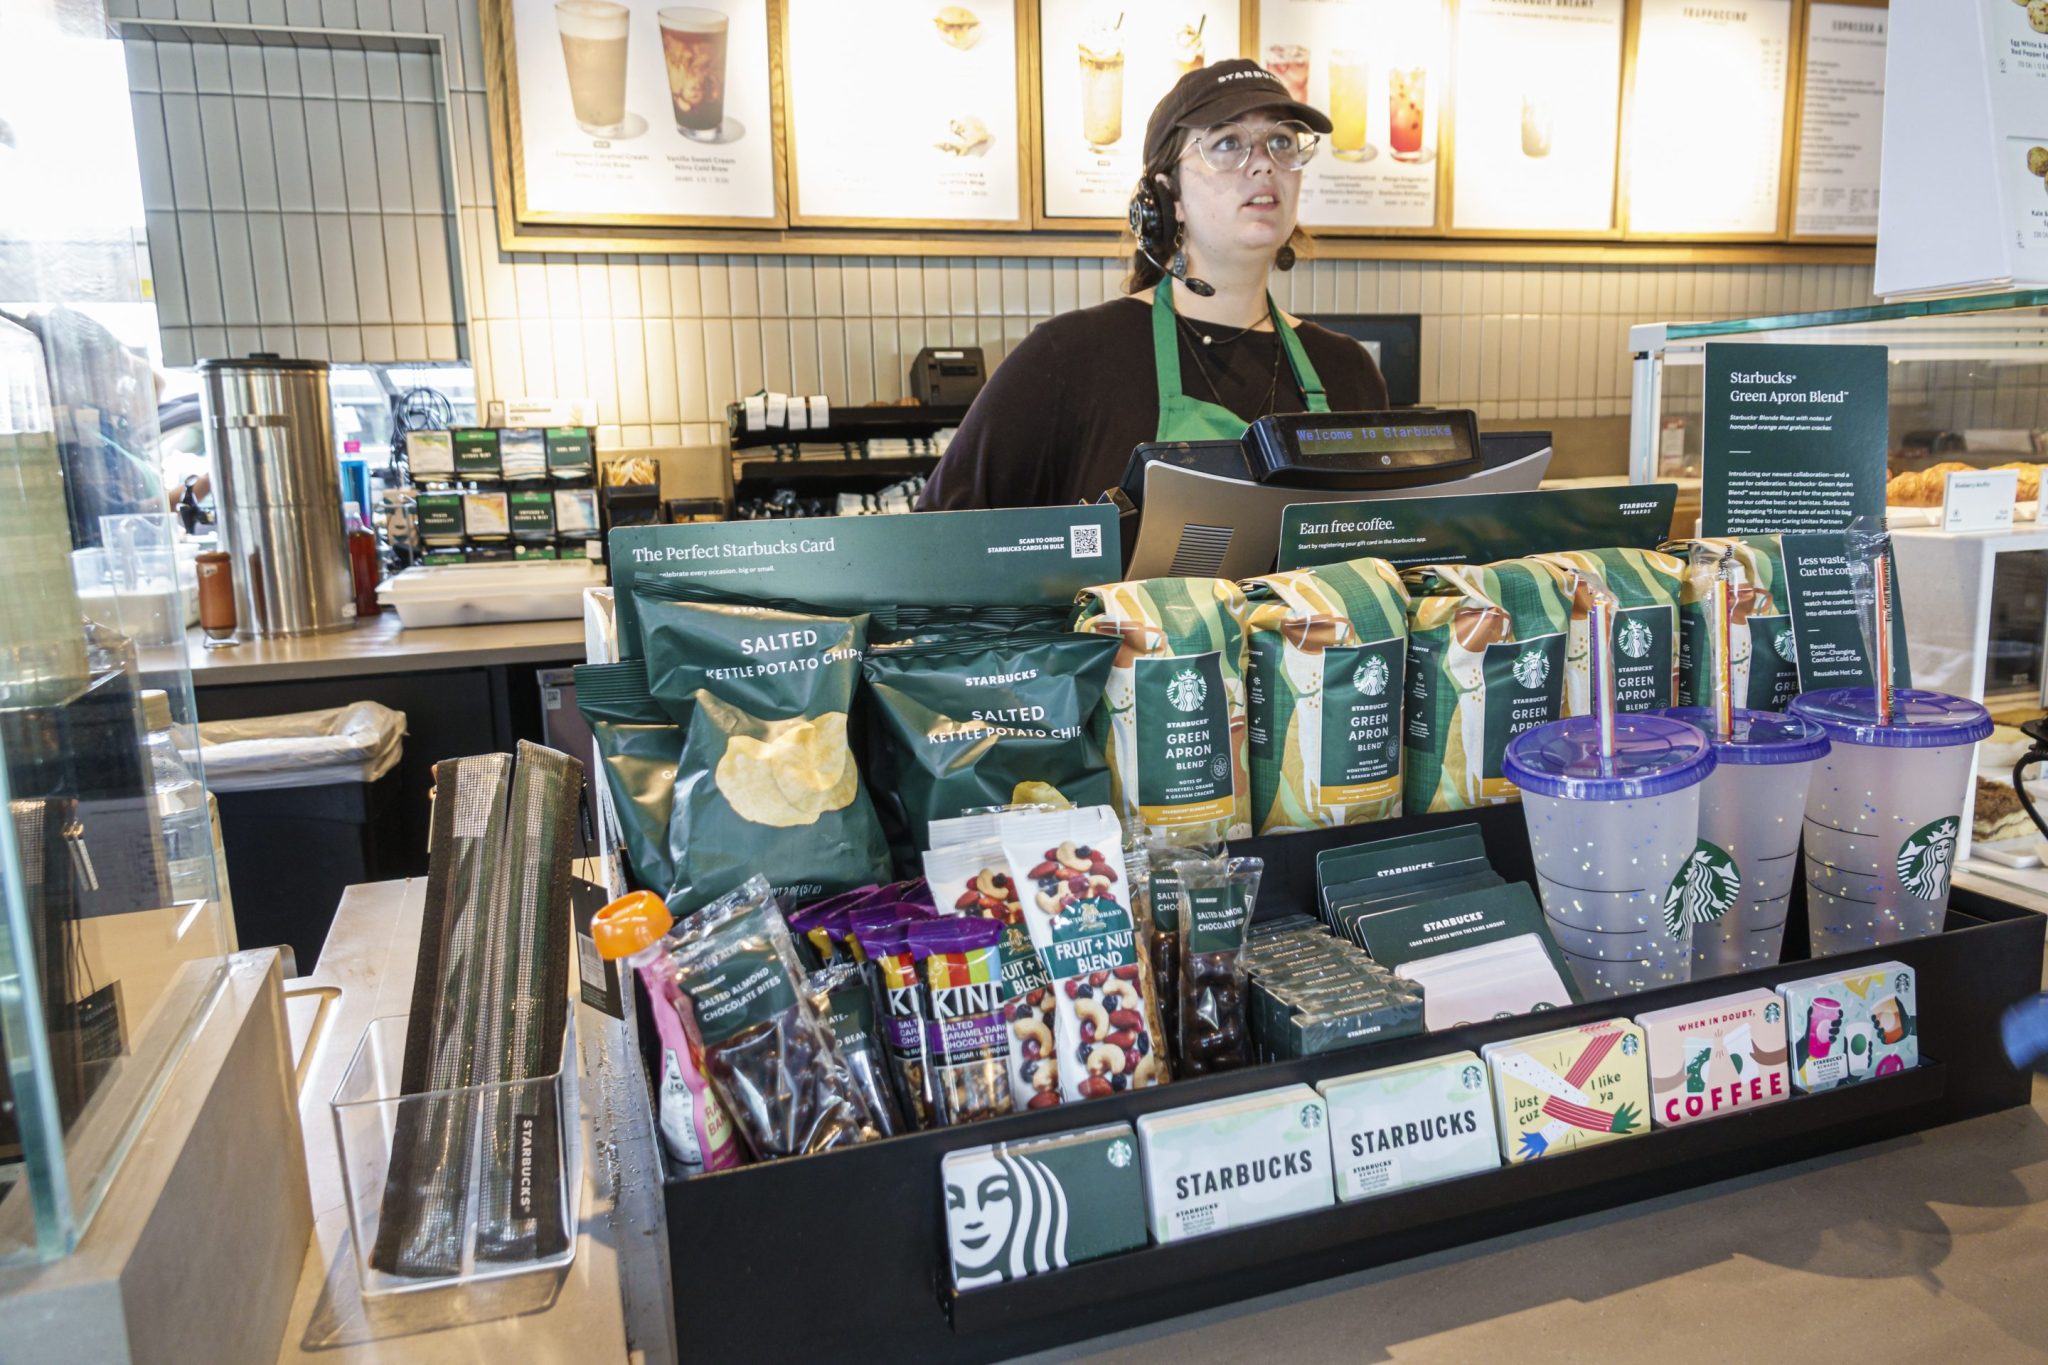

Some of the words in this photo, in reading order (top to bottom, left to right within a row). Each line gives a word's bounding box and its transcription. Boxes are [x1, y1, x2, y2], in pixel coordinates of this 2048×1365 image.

[1217, 70, 1281, 83] STARBU
[1730, 371, 1796, 384] Starbucks
[1730, 391, 1767, 402] Green
[1769, 391, 1806, 404] Apron
[1297, 429, 1353, 441] Welcome
[1362, 428, 1376, 439] to
[1384, 425, 1452, 438] Starbucks
[1300, 522, 1328, 535] Earn
[1331, 519, 1354, 533] free
[1357, 517, 1395, 531] coffee.
[633, 547, 663, 562] The
[666, 544, 720, 560] Perfect
[723, 540, 798, 557] Starbucks
[800, 537, 835, 553] Card
[1318, 541, 1344, 550] registering
[1357, 539, 1366, 547] gift
[1798, 557, 1818, 565] Less
[1819, 556, 1848, 564] waste.
[1800, 568, 1817, 576] Cue
[1818, 566, 1834, 576] the
[741, 629, 818, 655] SALTED
[705, 668, 754, 680] KETTLE
[757, 657, 819, 676] POTATO
[822, 648, 863, 665] CHIPS
[1618, 665, 1654, 673] STARBUCKS
[965, 669, 1038, 687] STARBUCKS
[1618, 675, 1655, 688] GREEN
[1512, 695, 1548, 704] STARBUCKS
[1617, 688, 1656, 701] APRON
[972, 705, 1045, 722] SALTED
[1352, 702, 1388, 712] STARBUCKS
[1512, 706, 1548, 720] GREEN
[1625, 702, 1650, 711] BLEND
[1167, 719, 1209, 729] STARBUCKS
[1351, 713, 1389, 727] GREEN
[928, 729, 982, 744] KETTLE
[986, 727, 1047, 738] POTATO
[1167, 730, 1210, 745] GREEN
[1349, 727, 1389, 741] APRON
[1165, 744, 1212, 759] APRON
[1358, 741, 1383, 752] BLEND
[1176, 760, 1206, 770] BLEND
[1423, 911, 1484, 932] STARBUCKS
[1409, 939, 1422, 948] LOAD
[1423, 937, 1434, 945] FIVE
[1434, 934, 1450, 942] CARDS
[1450, 931, 1463, 939] WITH
[1486, 920, 1506, 930] AMOUNT
[1055, 939, 1093, 960] FRUIT
[1095, 941, 1103, 949] +
[1106, 930, 1133, 950] NUT
[1077, 951, 1122, 973] BLEND
[698, 992, 731, 1010] SALTED
[731, 967, 769, 994] ALMOND
[703, 991, 757, 1022] CHOCOLATE
[757, 975, 781, 995] BITES
[1678, 1019, 1706, 1032] WHEN
[1708, 1016, 1719, 1027] IN
[1722, 1009, 1756, 1024] DOUBT,
[1347, 1025, 1381, 1038] STARBUCKS
[1813, 1055, 1843, 1066] STARBUCKS
[1591, 1076, 1596, 1091] I
[1598, 1071, 1621, 1090] like
[1514, 1095, 1539, 1112] just
[1600, 1089, 1614, 1104] ya
[1665, 1072, 1783, 1123] COFFEE
[1519, 1109, 1541, 1126] cuz
[1351, 1109, 1478, 1157] STARBUCKS
[520, 1120, 533, 1207] STARBUCKS
[1353, 1160, 1392, 1173] STARBUCKS
[1176, 1149, 1313, 1200] STARBUCKS
[1176, 1202, 1219, 1218] STARBUCKS
